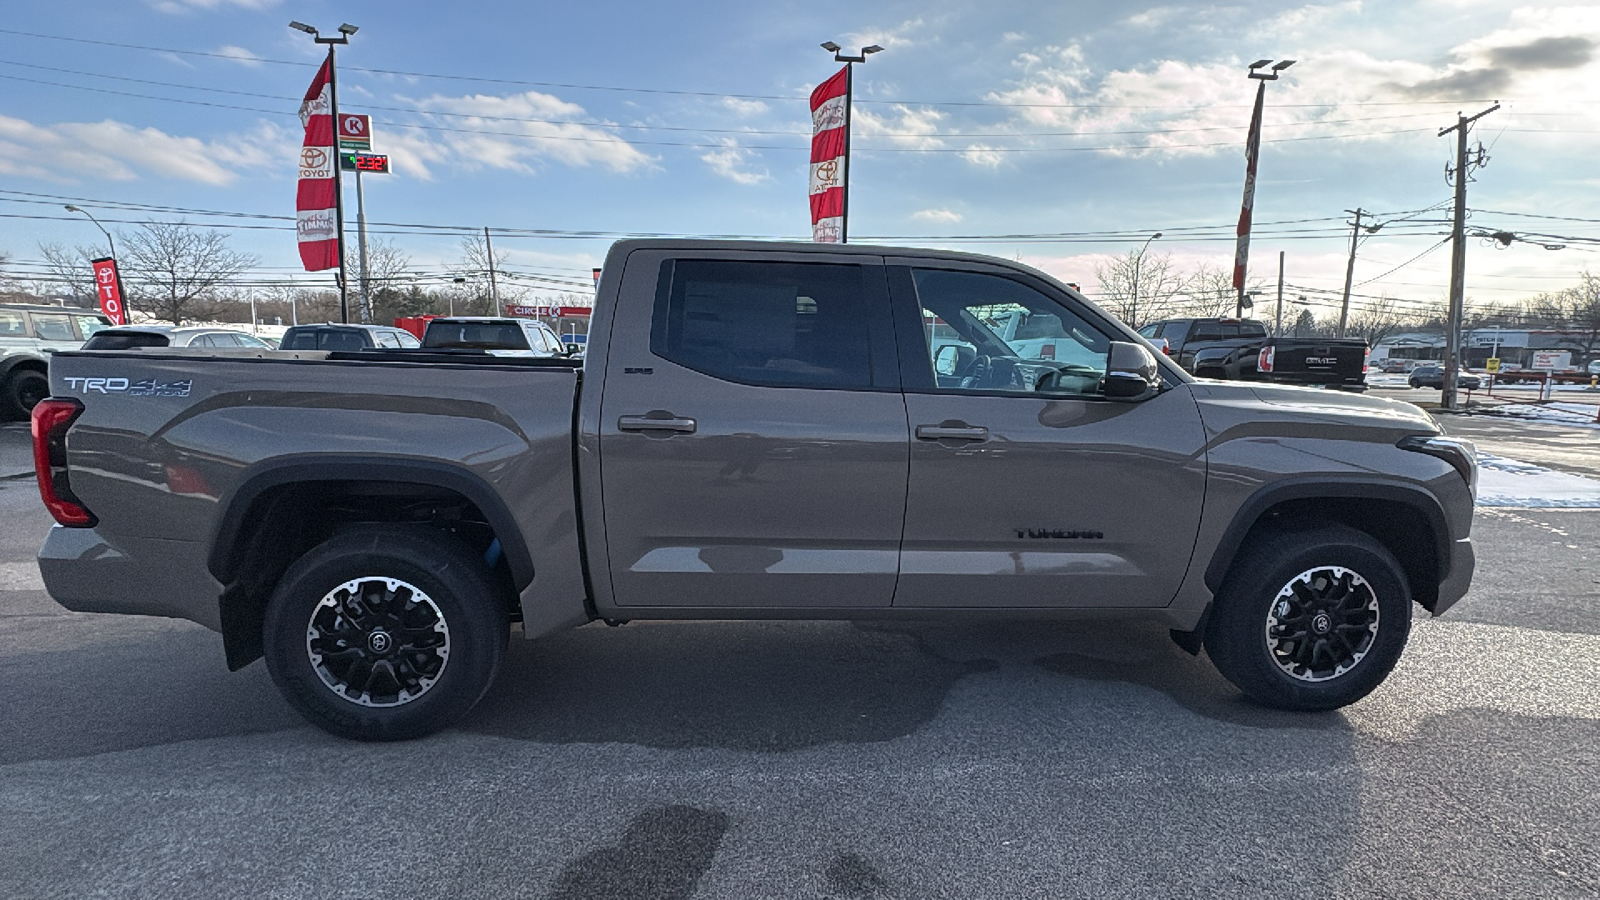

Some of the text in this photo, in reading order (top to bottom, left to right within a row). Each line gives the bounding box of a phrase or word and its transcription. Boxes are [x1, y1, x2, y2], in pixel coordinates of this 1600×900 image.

[514, 306, 547, 316] CIRCLE
[64, 376, 130, 394] TRD
[1013, 528, 1104, 539] TUNDRA
